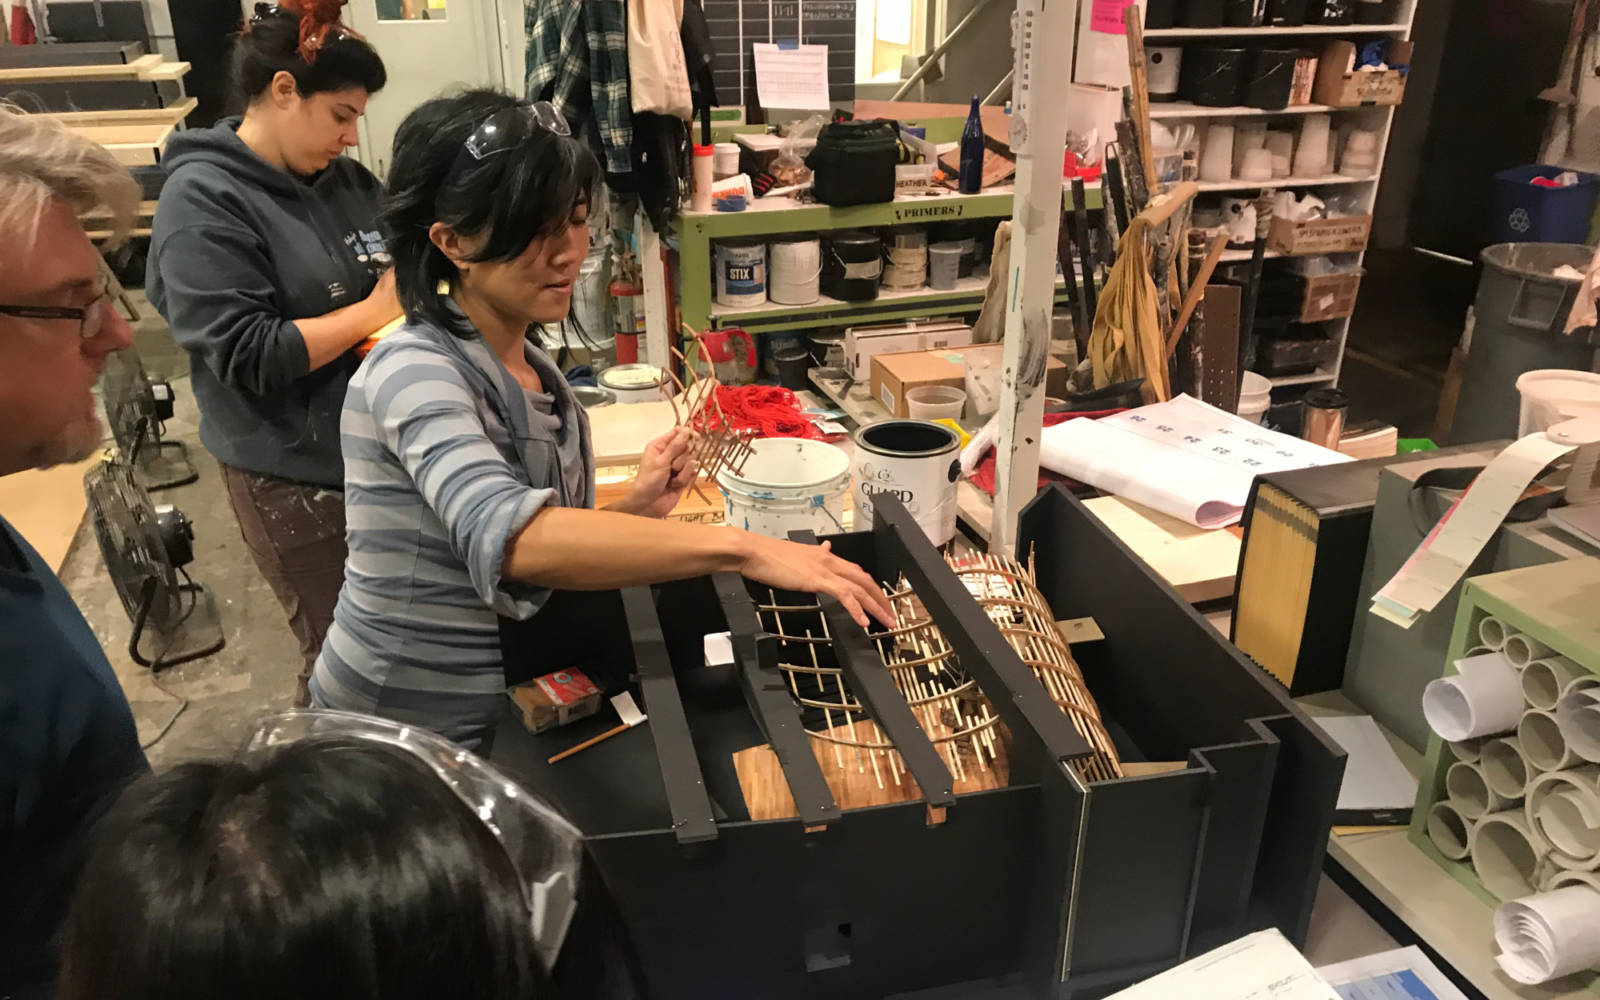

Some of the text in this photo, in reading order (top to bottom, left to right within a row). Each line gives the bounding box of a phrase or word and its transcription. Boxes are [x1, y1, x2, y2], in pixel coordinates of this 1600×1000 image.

[904, 205, 955, 217] PRIMERS
[729, 268, 750, 280] STIX
[861, 482, 914, 504] GURD
